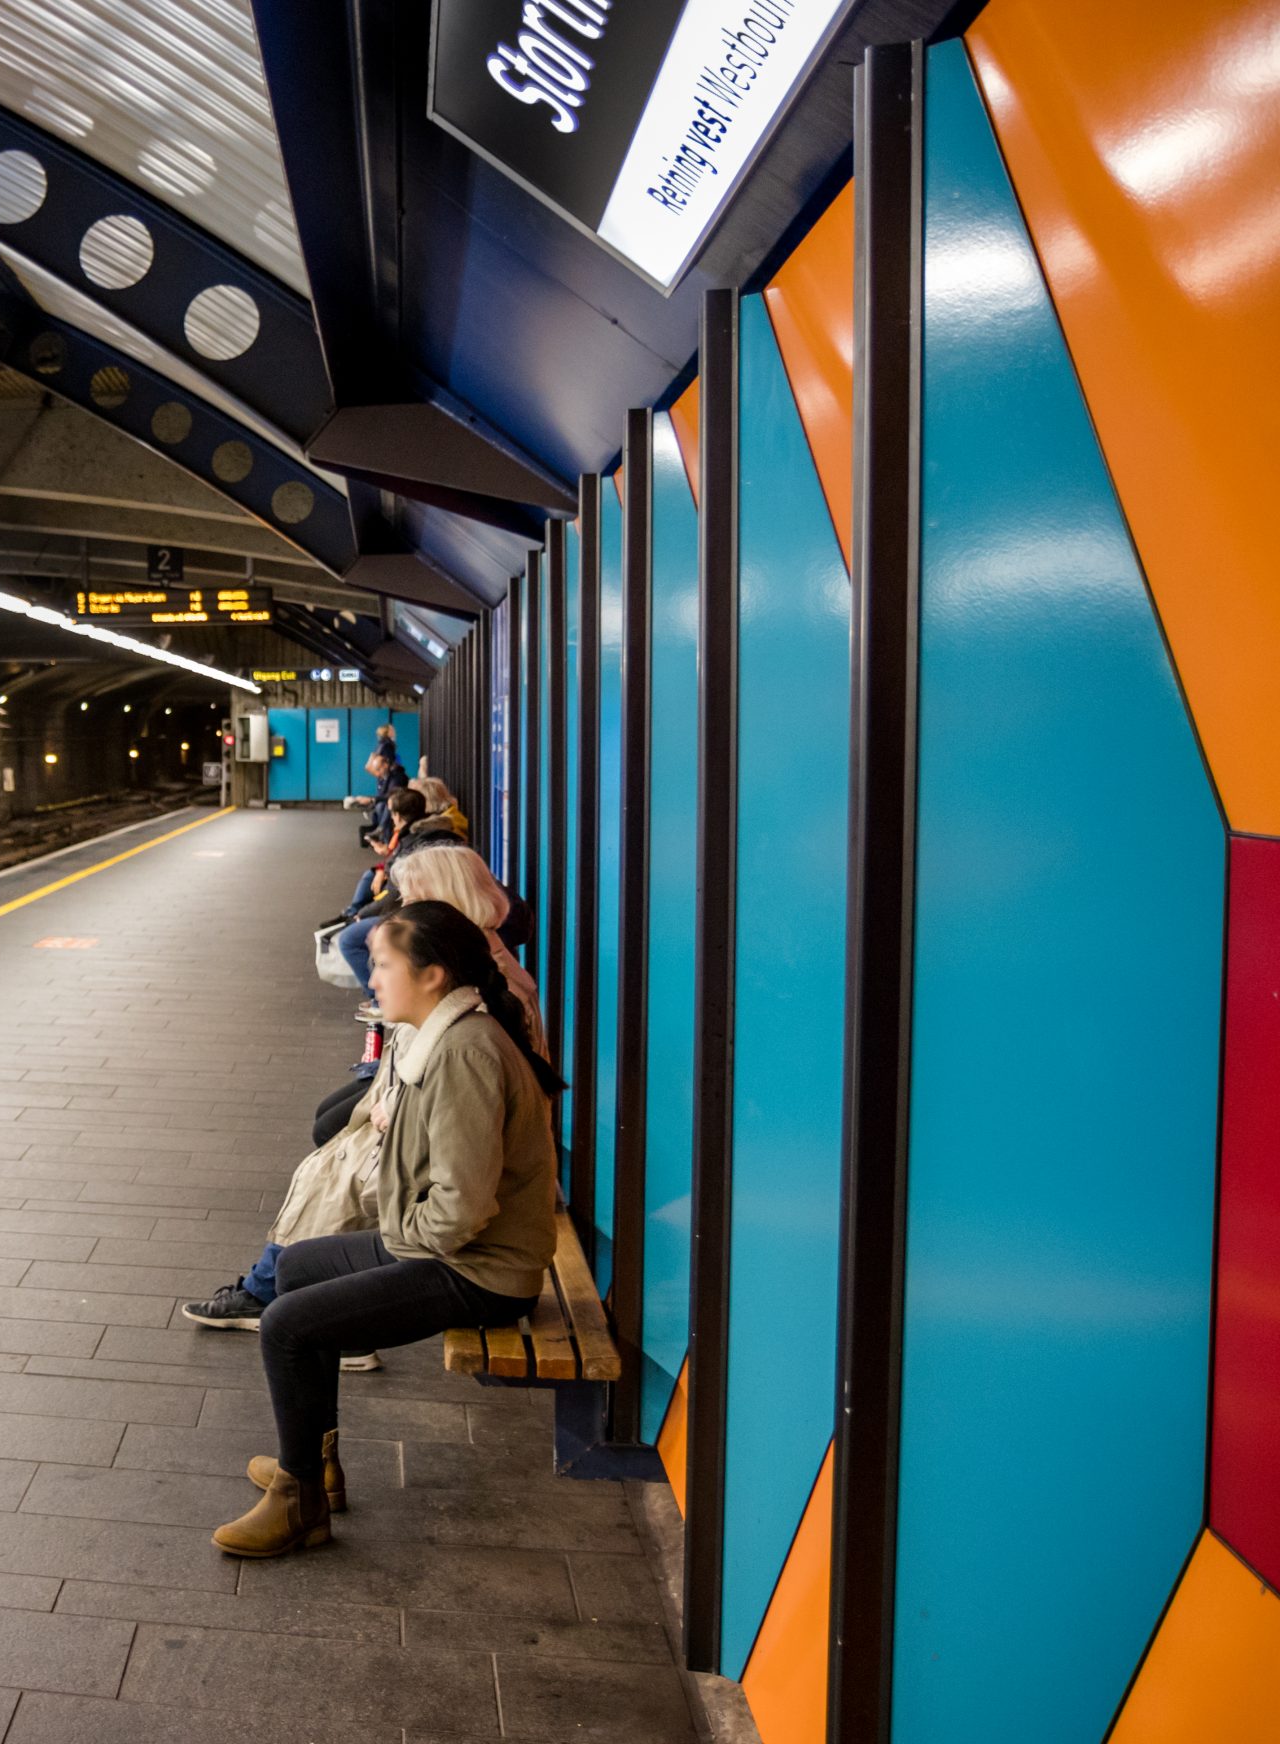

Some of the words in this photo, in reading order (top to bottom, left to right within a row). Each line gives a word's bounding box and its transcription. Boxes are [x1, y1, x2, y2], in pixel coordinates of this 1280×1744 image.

[486, 0, 615, 133] Stort
[646, 144, 718, 216] Retning
[685, 96, 733, 152] vest
[158, 550, 171, 570] 2
[253, 671, 281, 682] Utgang
[281, 670, 297, 681] Exit
